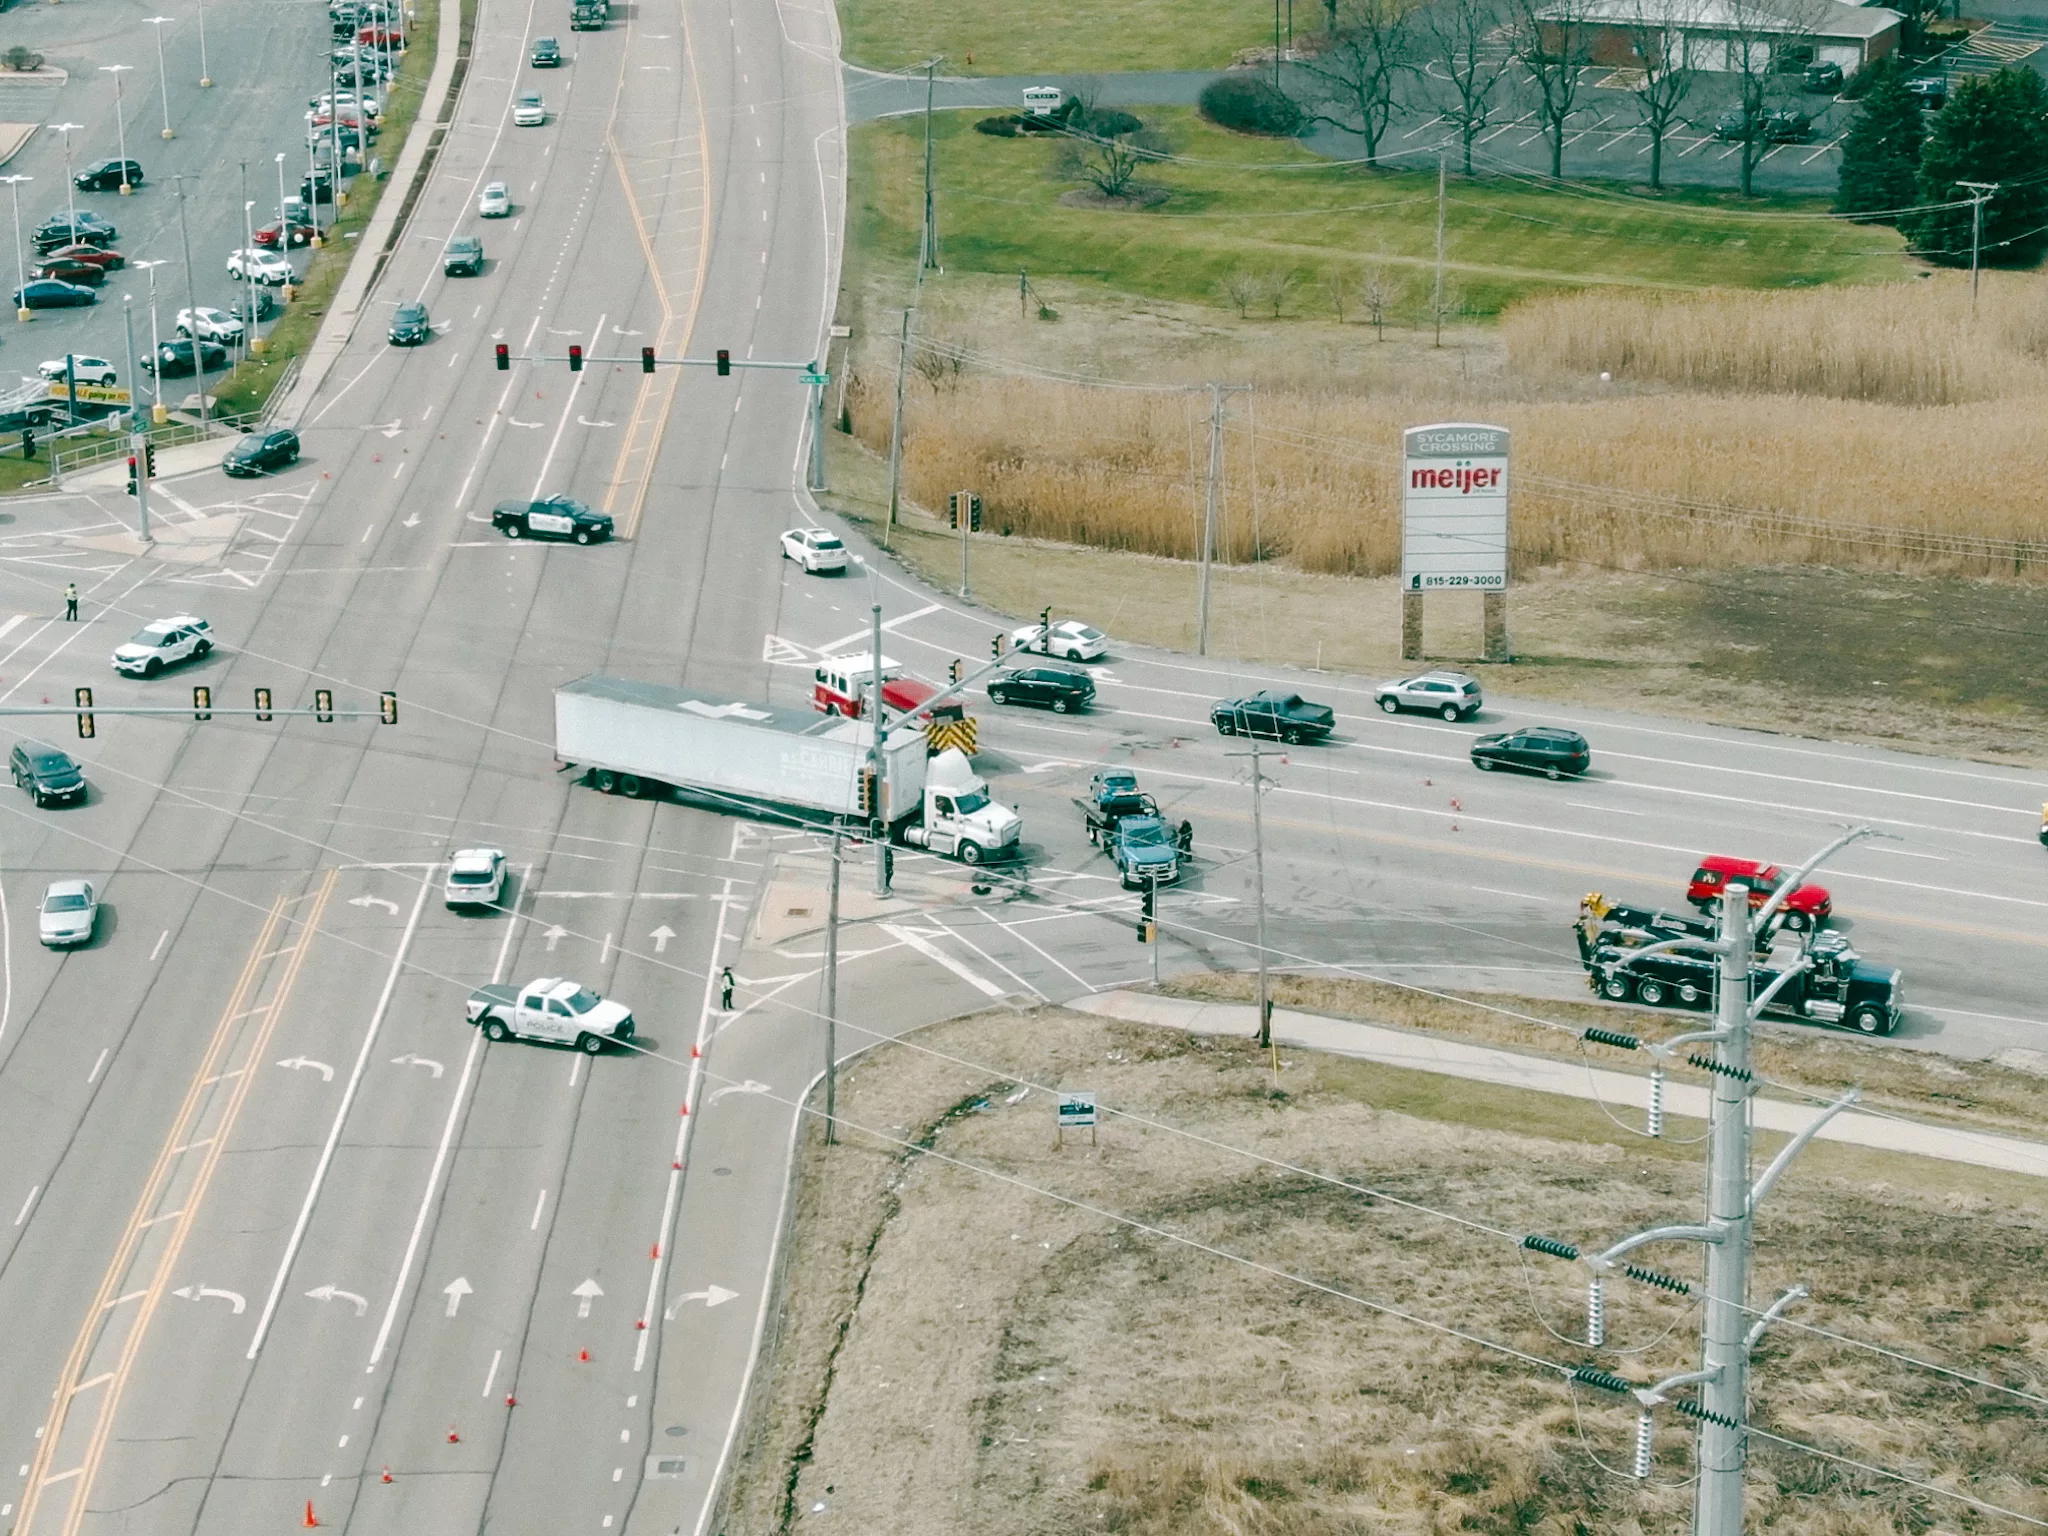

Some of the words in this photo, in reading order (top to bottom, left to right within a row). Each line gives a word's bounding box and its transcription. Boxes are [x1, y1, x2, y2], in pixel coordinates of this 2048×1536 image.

[1416, 432, 1500, 444] SYCAMORE
[1419, 441, 1496, 453] CROSSING
[1411, 460, 1502, 495] meijer
[1425, 575, 1502, 586] 815-229-3000
[526, 1020, 566, 1034] POLICE
